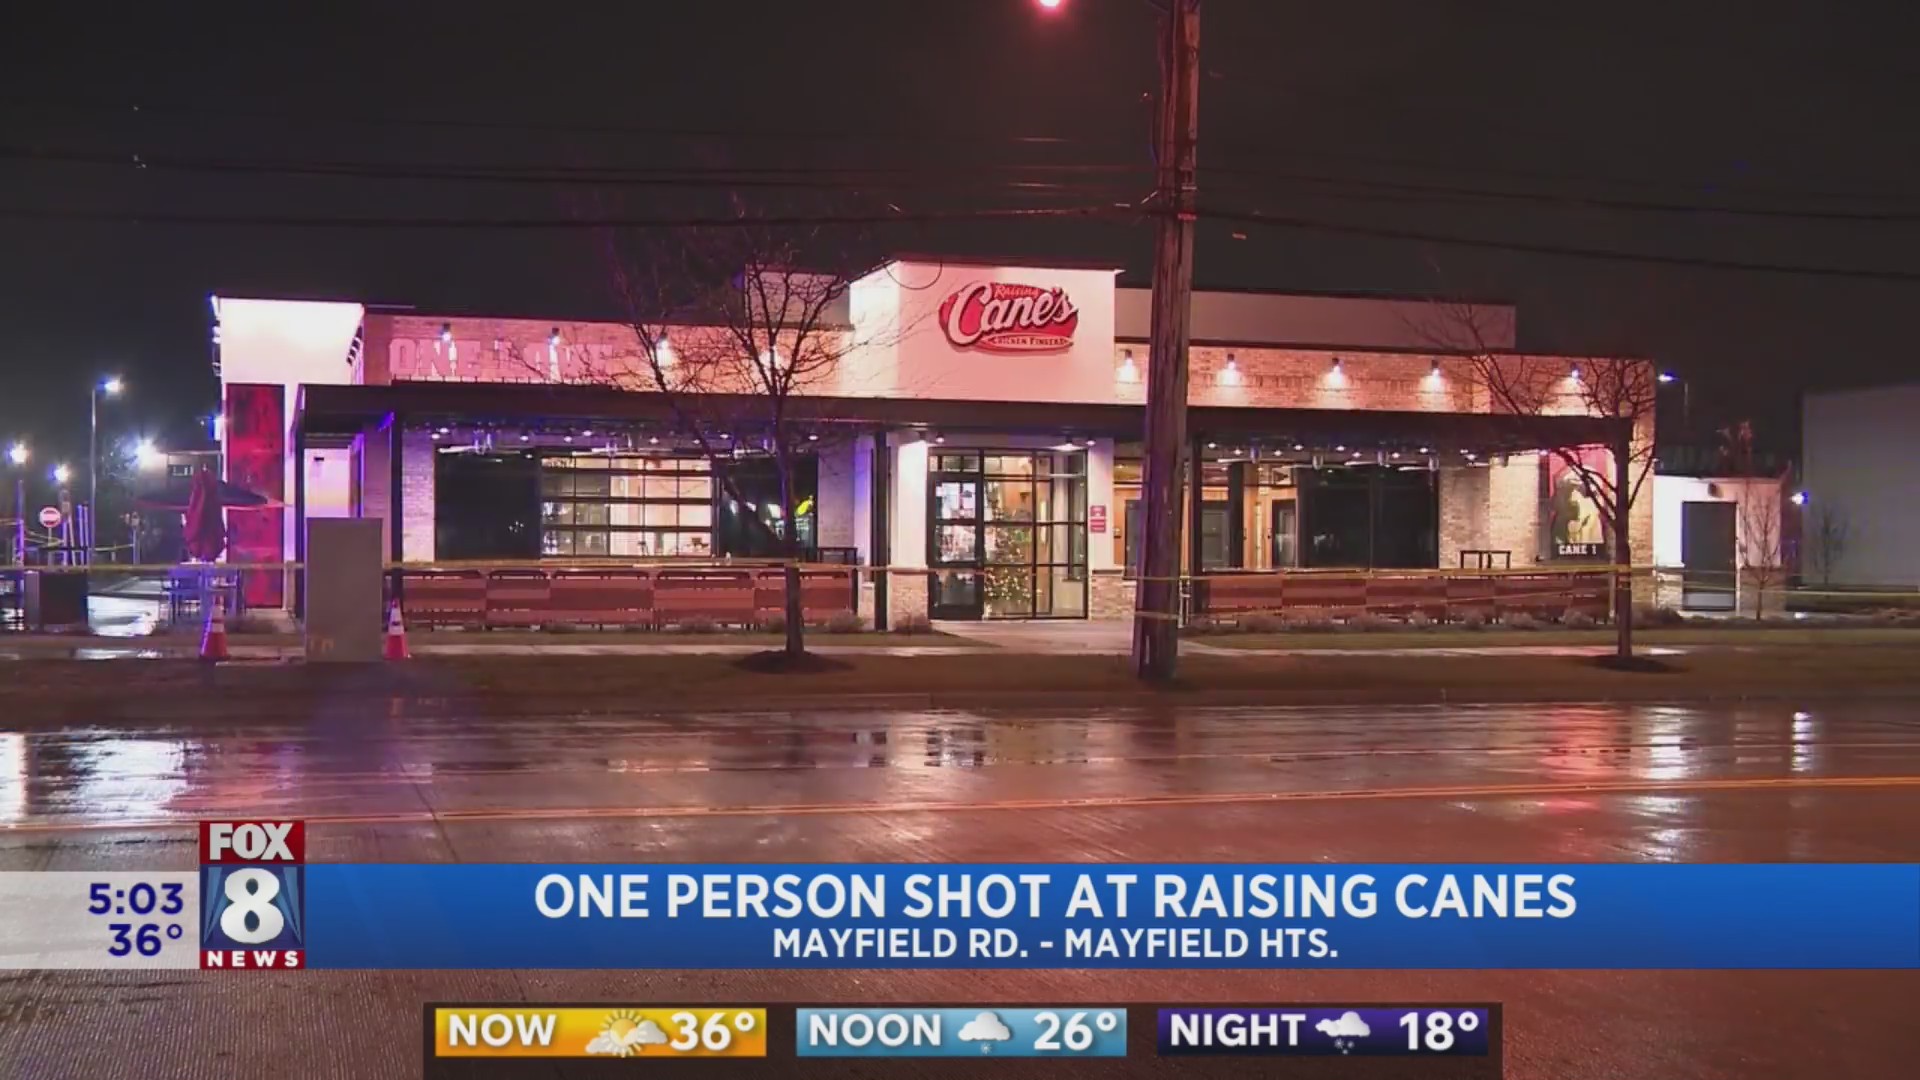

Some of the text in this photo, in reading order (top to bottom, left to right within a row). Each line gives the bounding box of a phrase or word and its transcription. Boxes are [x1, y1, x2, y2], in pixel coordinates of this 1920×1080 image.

[994, 284, 1040, 299] Raising
[947, 281, 1079, 345] Cane's
[389, 338, 614, 380] ONE LOVE
